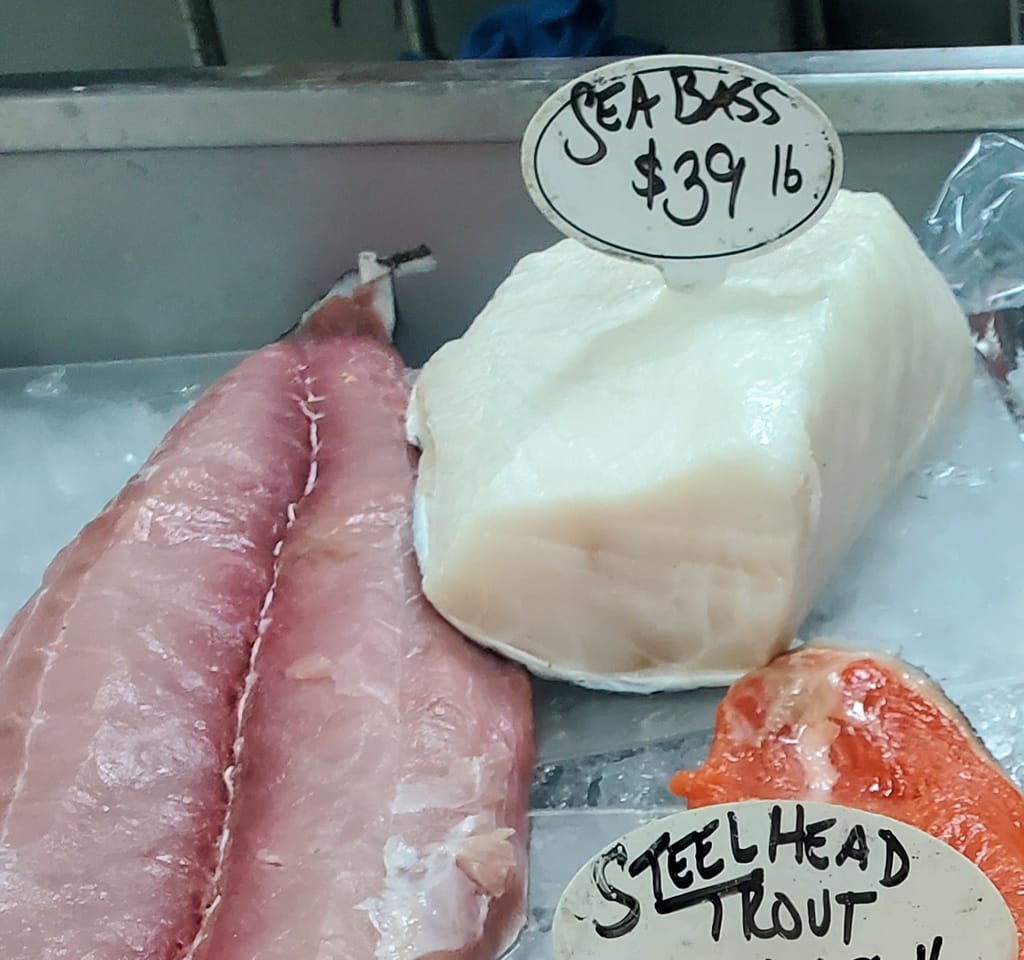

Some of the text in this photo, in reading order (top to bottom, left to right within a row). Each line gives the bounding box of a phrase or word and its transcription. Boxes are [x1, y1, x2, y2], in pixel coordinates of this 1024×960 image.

[563, 66, 788, 165] SEA BASS
[631, 137, 746, 227] $39
[654, 867, 878, 945] TROUT
